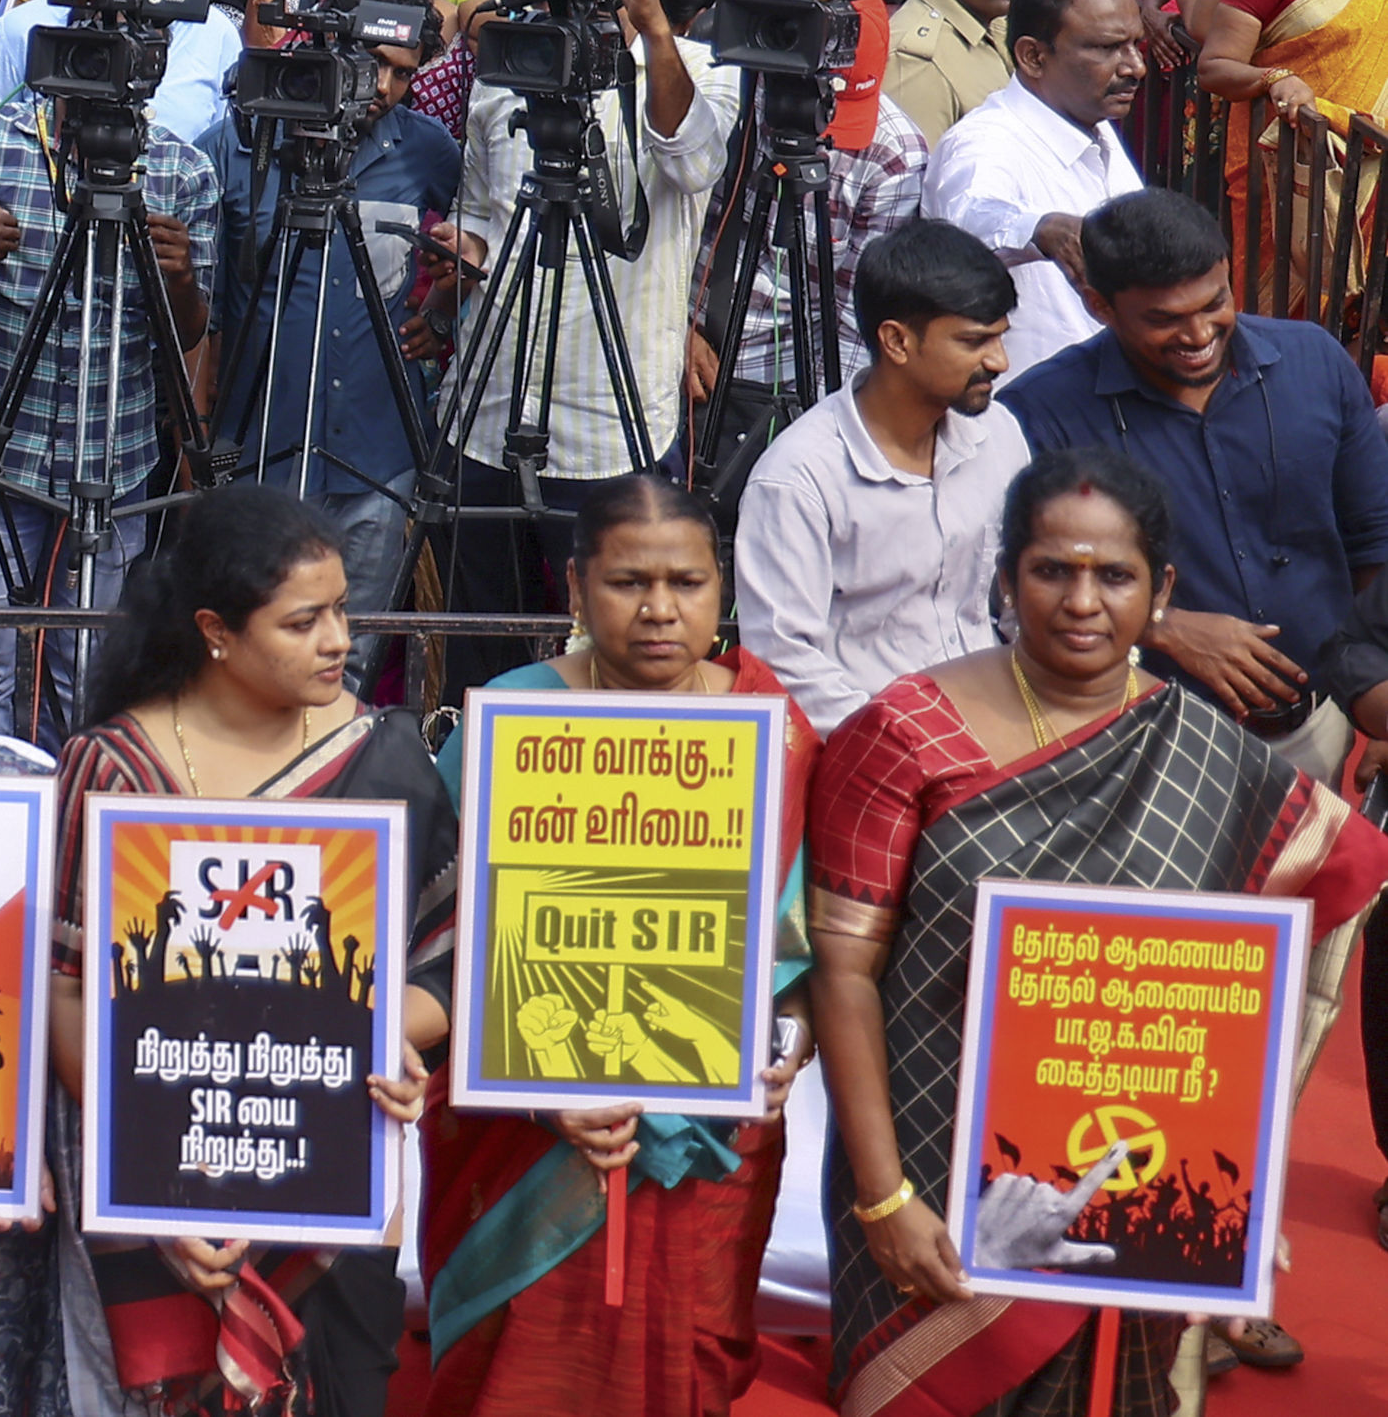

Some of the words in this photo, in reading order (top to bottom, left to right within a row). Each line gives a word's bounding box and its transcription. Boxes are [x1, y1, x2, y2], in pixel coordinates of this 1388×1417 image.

[595, 168, 610, 209] SONY
[516, 723, 585, 774] என்
[593, 725, 735, 790] வாக்கு..!
[508, 793, 577, 844] என்
[585, 791, 744, 849] உரிமை..!!
[534, 905, 617, 955] Quit
[1012, 923, 1100, 965] தேர்தல்
[1104, 933, 1265, 973] ஆணையமே
[1009, 966, 1096, 1008] தேர்தல்
[1101, 977, 1261, 1015] ஆணையமே
[133, 1027, 241, 1083] நிறுத்து
[245, 1030, 353, 1086] நிறுத்து
[1055, 1014, 1208, 1056] பா.ஜ.க.வின்
[1035, 1055, 1178, 1102] கைத்தடியா
[190, 1088, 231, 1126] SIR
[237, 1094, 297, 1128] யை
[178, 1124, 307, 1180] நிறுத்து..!
